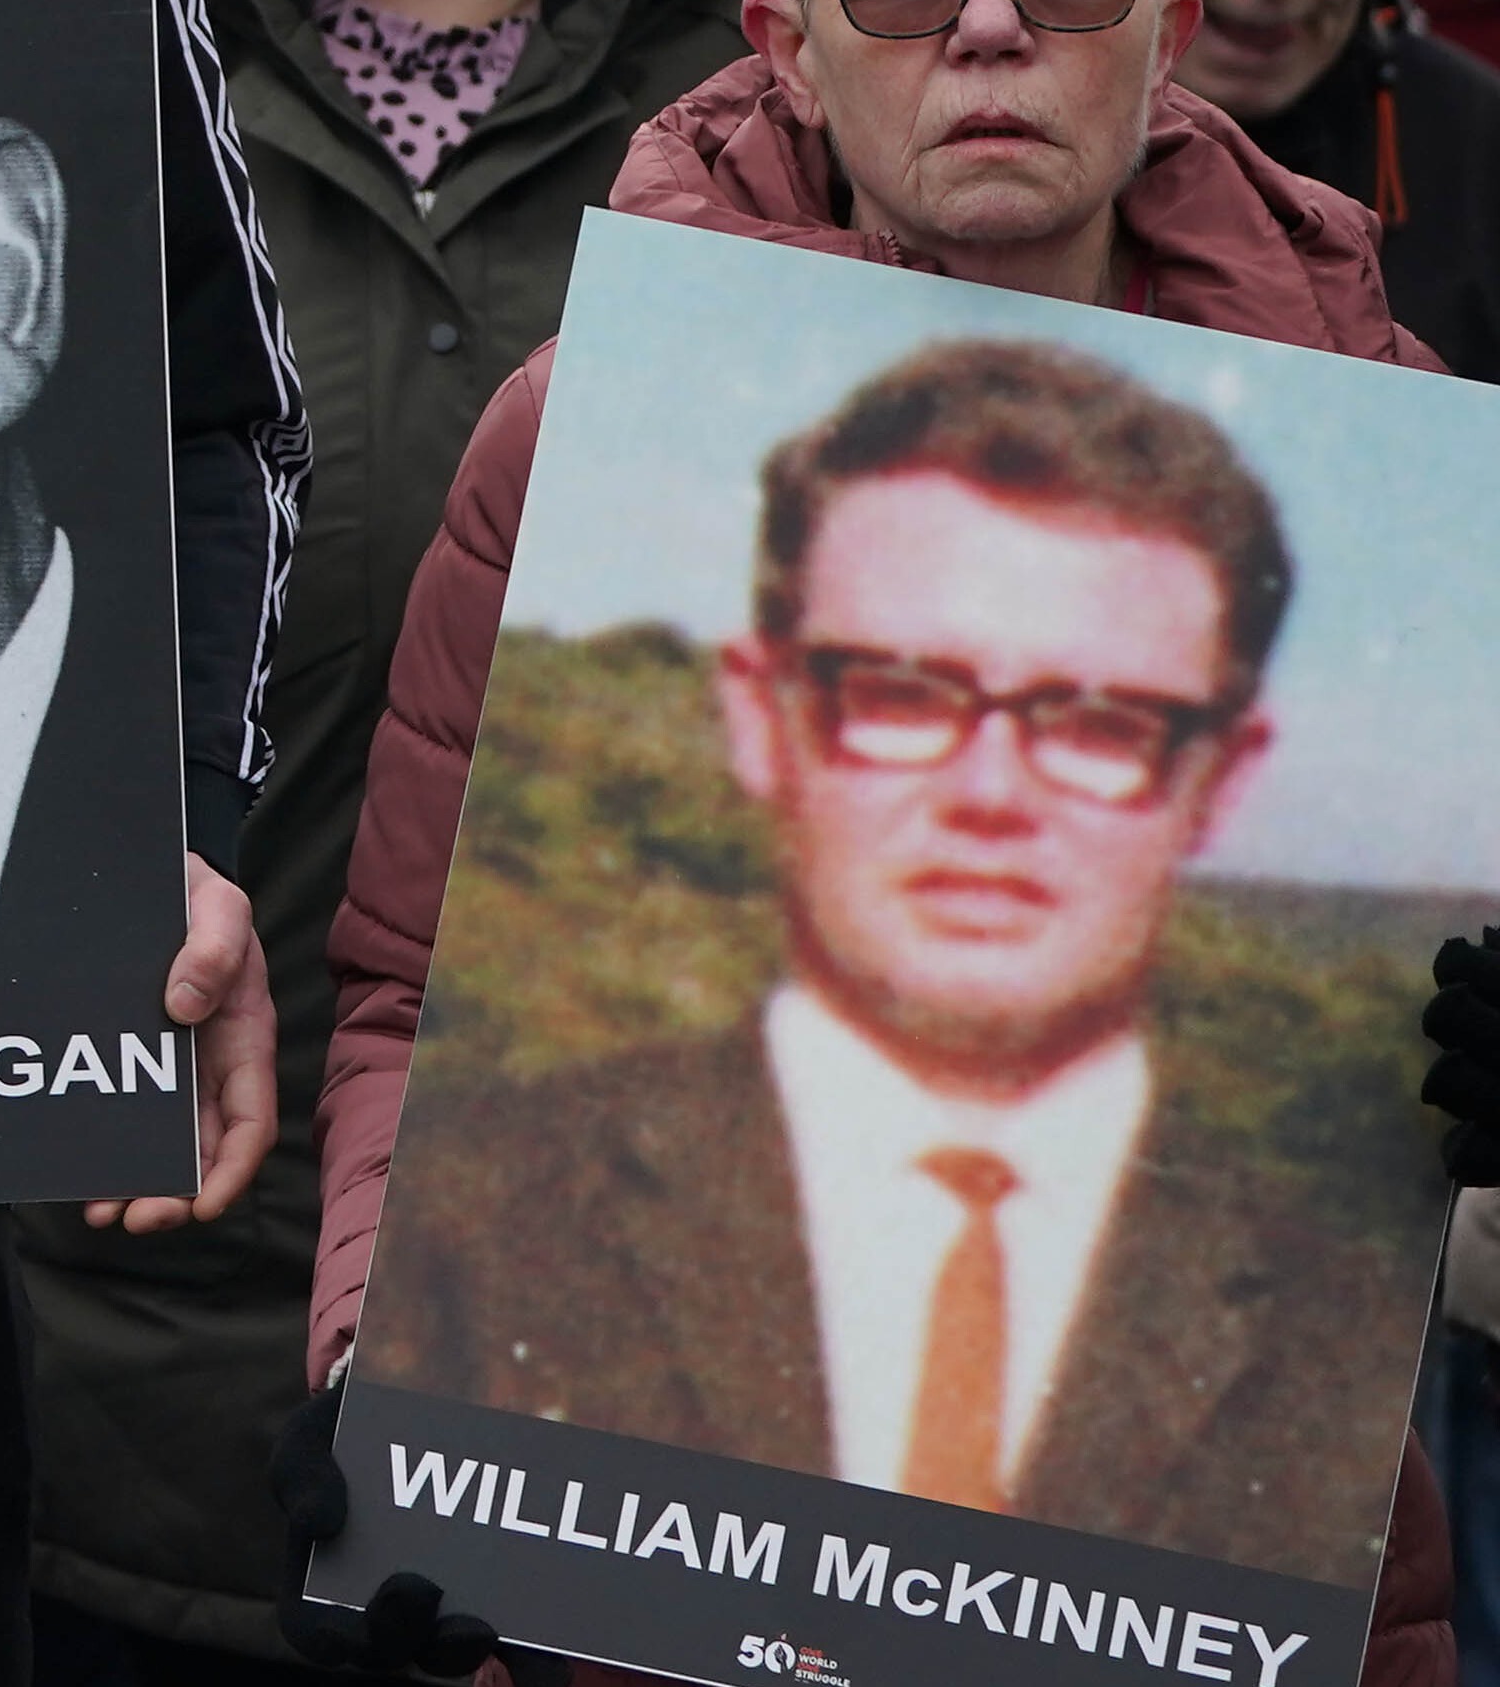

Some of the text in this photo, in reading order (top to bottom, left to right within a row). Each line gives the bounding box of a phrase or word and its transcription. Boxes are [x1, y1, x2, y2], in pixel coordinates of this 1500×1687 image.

[389, 1443, 1310, 1687] WILLIAM McKINNEY
[799, 1654, 838, 1670] WORLD
